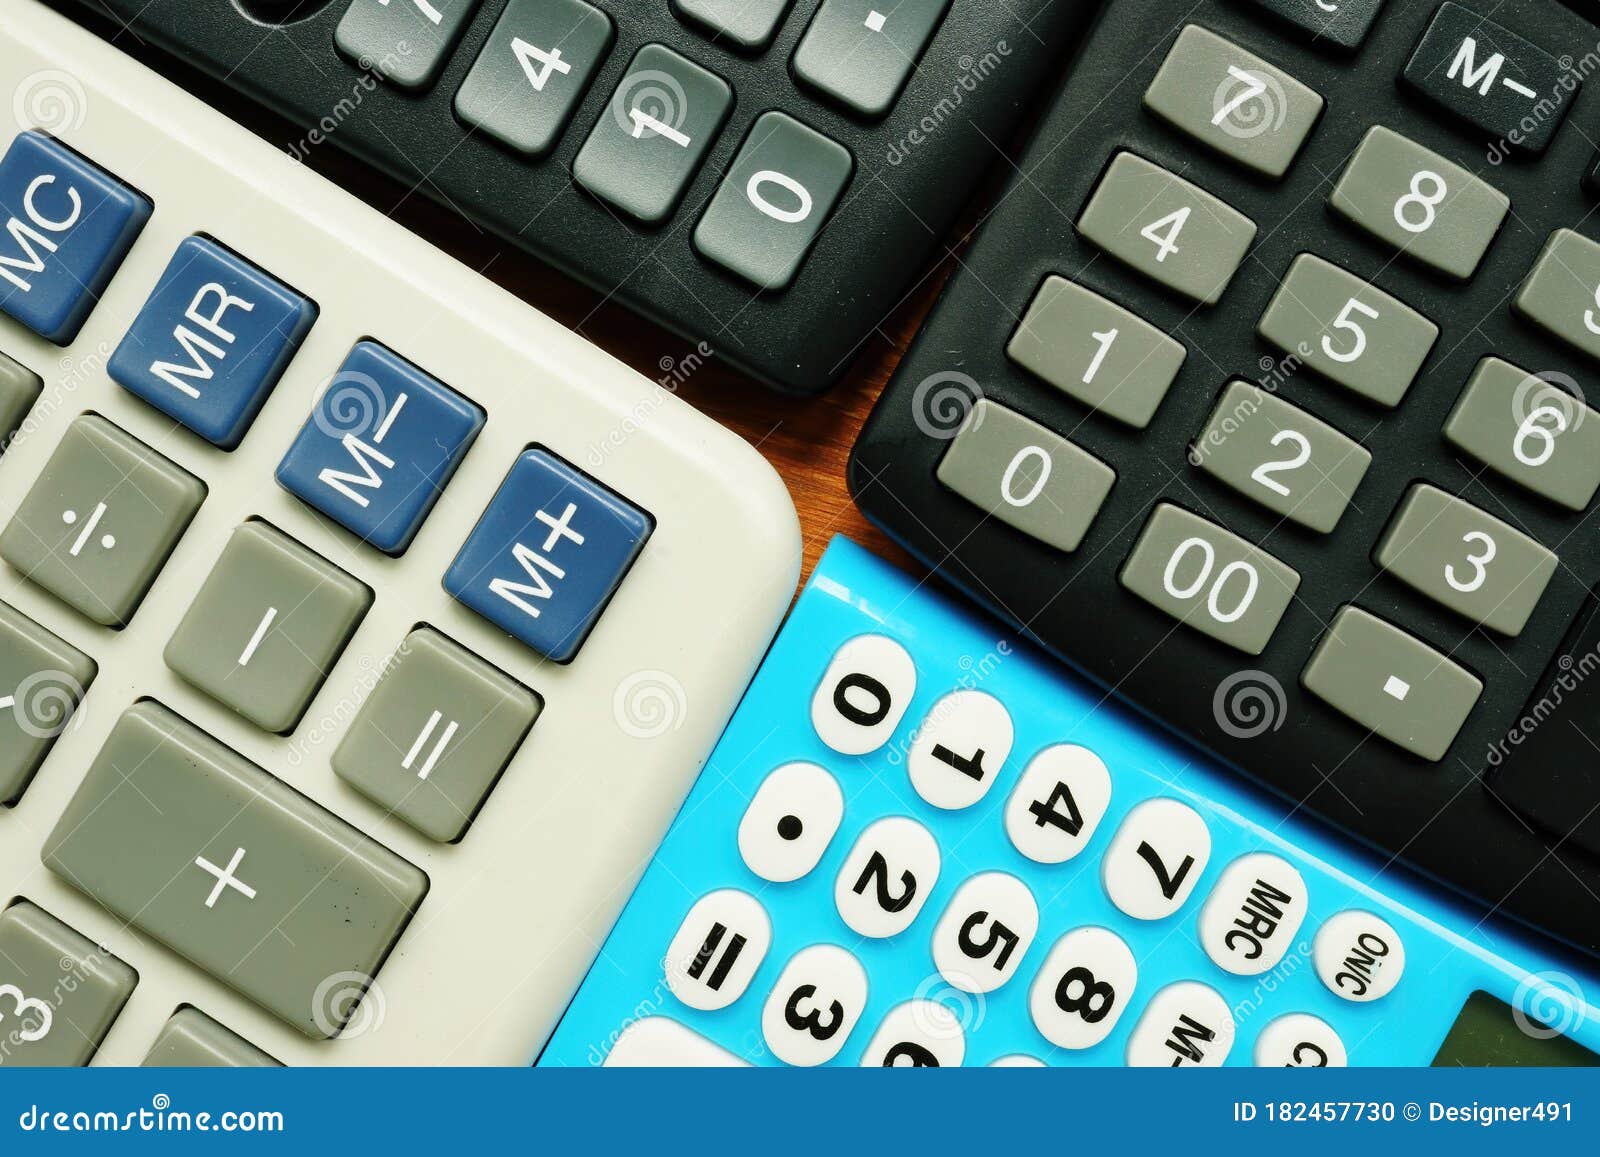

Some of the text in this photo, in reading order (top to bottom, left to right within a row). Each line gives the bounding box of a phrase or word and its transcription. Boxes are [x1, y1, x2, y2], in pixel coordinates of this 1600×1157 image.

[510, 37, 572, 91] 4
[1446, 37, 1537, 98] M-
[1211, 65, 1267, 126] 7
[628, 108, 691, 148] 1
[746, 170, 812, 222] 0
[1394, 170, 1447, 232] 8
[0, 174, 82, 292] MC
[1140, 206, 1191, 262] 4
[149, 282, 254, 399] MR
[1082, 328, 1118, 384] 1
[1321, 298, 1379, 363] 5
[318, 392, 407, 508] M-
[1251, 430, 1312, 497] 2
[1512, 406, 1567, 467] 6
[1000, 445, 1051, 507] 0
[487, 503, 585, 618] M+
[1163, 537, 1259, 623] 00
[1444, 531, 1497, 593] 3
[833, 673, 892, 727] 0
[931, 743, 985, 782] 1
[1028, 780, 1084, 837] 4
[852, 850, 917, 913] 2
[1136, 840, 1195, 901] 7
[958, 911, 1020, 972] 5
[1224, 879, 1292, 960] MRC
[1054, 966, 1115, 1024] 8
[1335, 933, 1389, 996] ON/C
[0, 983, 53, 1041] 3
[784, 984, 844, 1041] 3
